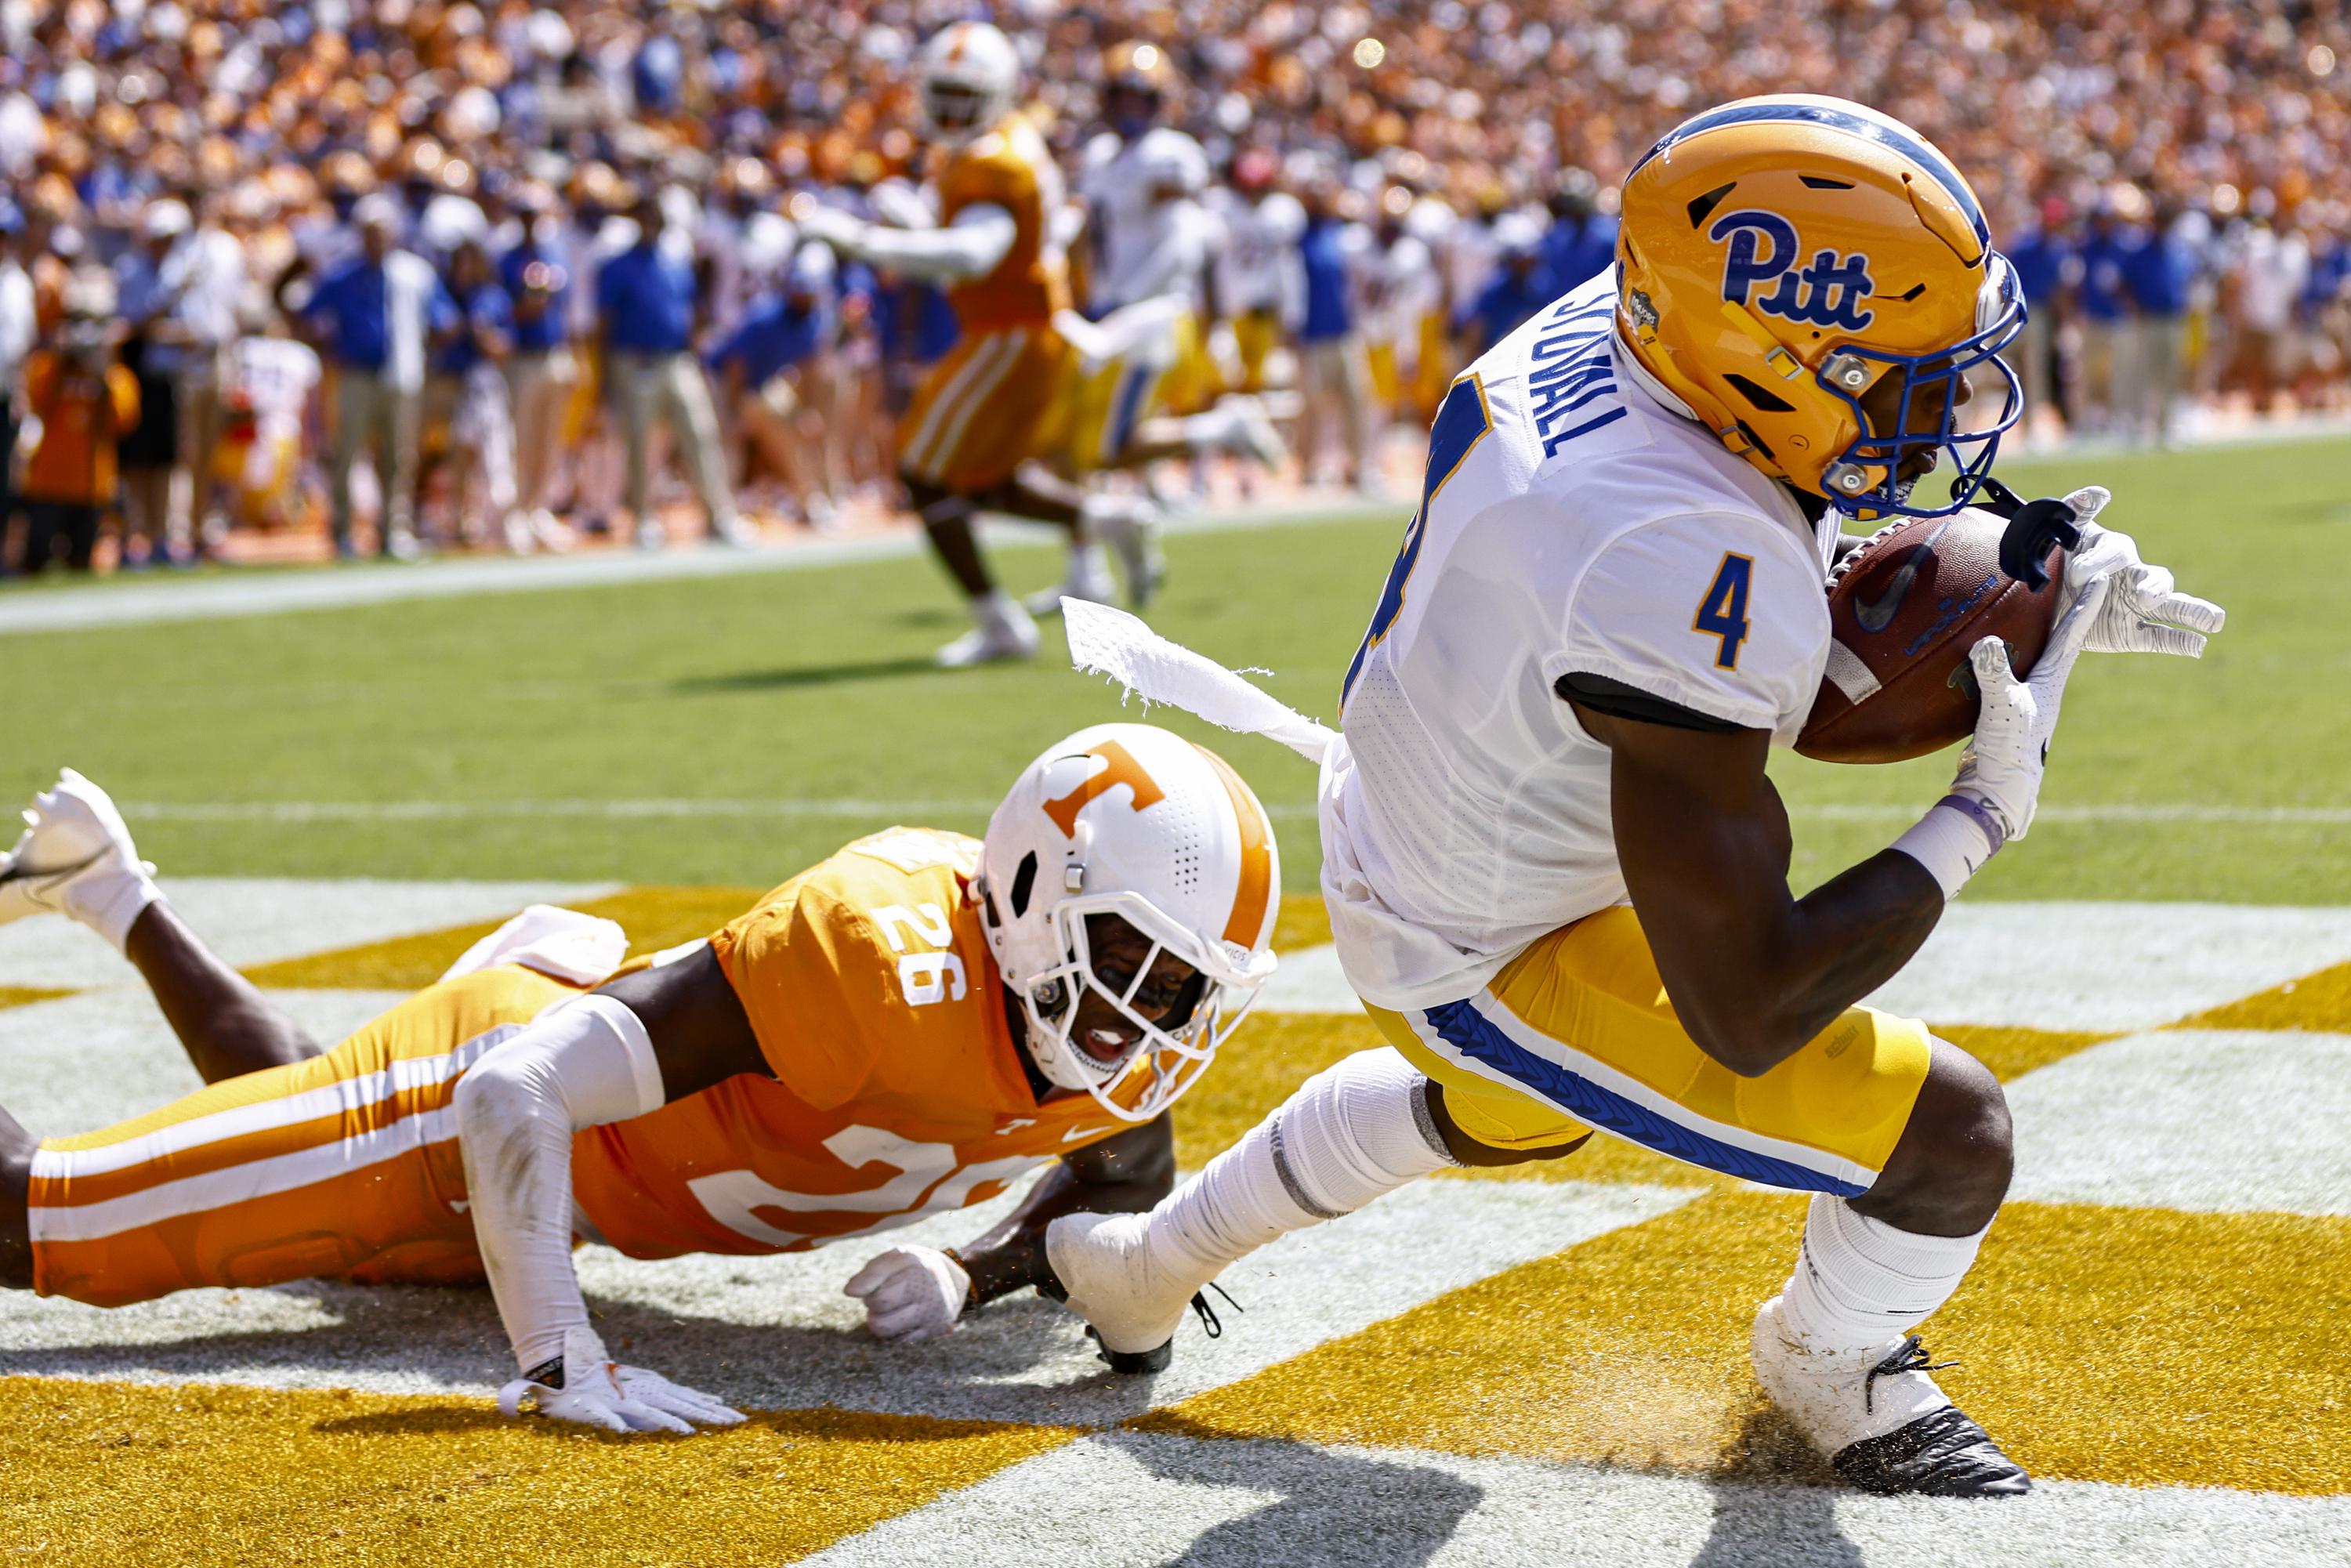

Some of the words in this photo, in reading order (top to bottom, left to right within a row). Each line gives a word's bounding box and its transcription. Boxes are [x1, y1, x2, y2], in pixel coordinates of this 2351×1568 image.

[1708, 209, 1875, 332] Pitt
[1692, 550, 1755, 672] 4
[1042, 739, 1165, 841] T
[869, 903, 967, 1007] 26
